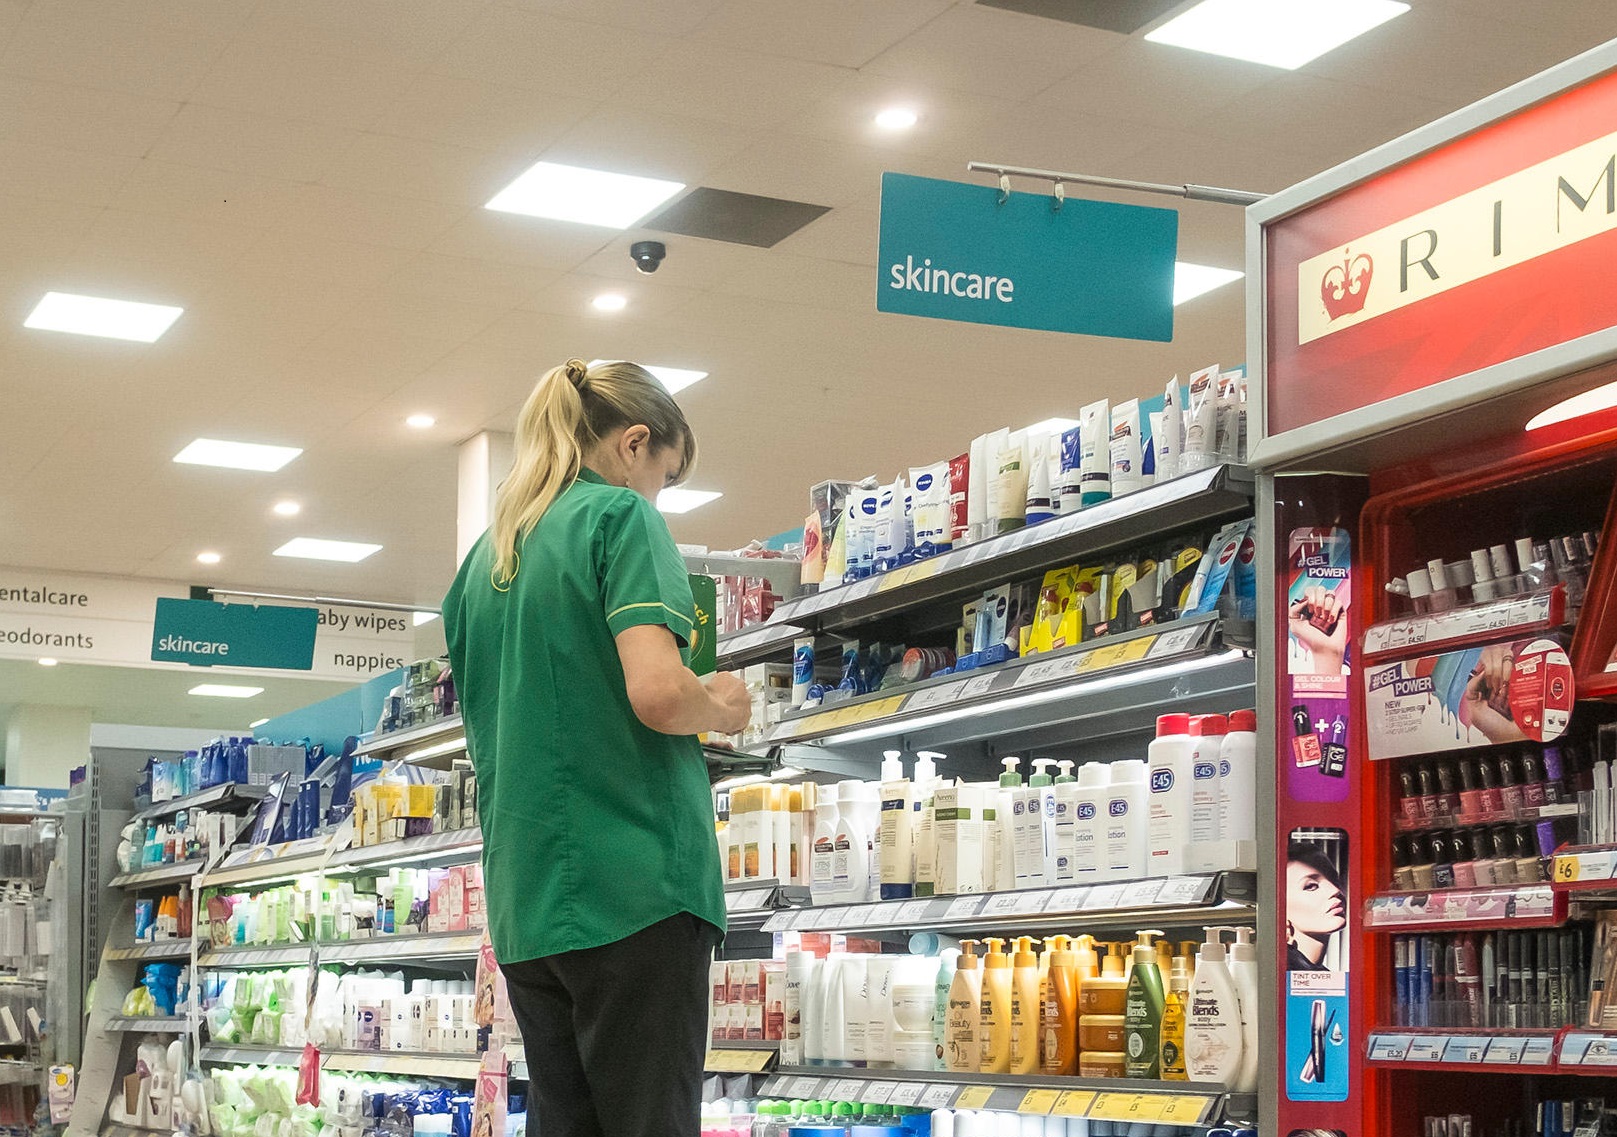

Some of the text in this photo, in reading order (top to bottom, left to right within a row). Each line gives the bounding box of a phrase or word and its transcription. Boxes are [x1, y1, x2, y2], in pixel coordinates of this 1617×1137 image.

[890, 255, 1014, 303] skincare
[1309, 567, 1346, 578] POWER
[0, 586, 88, 607] entalcare
[354, 612, 406, 634] wipes
[158, 634, 229, 655] skincare
[334, 652, 404, 672] nappies
[1372, 669, 1401, 689] #GEL
[1395, 677, 1432, 695] POWER
[1384, 700, 1401, 709] NEW
[1297, 714, 1304, 724] 1
[1334, 724, 1342, 734] 2
[1195, 766, 1211, 777] E45
[1153, 773, 1170, 788] E45
[1079, 806, 1093, 817] E45
[1111, 802, 1125, 813] E45
[1559, 863, 1572, 878] £6
[1192, 1005, 1220, 1016] Blends
